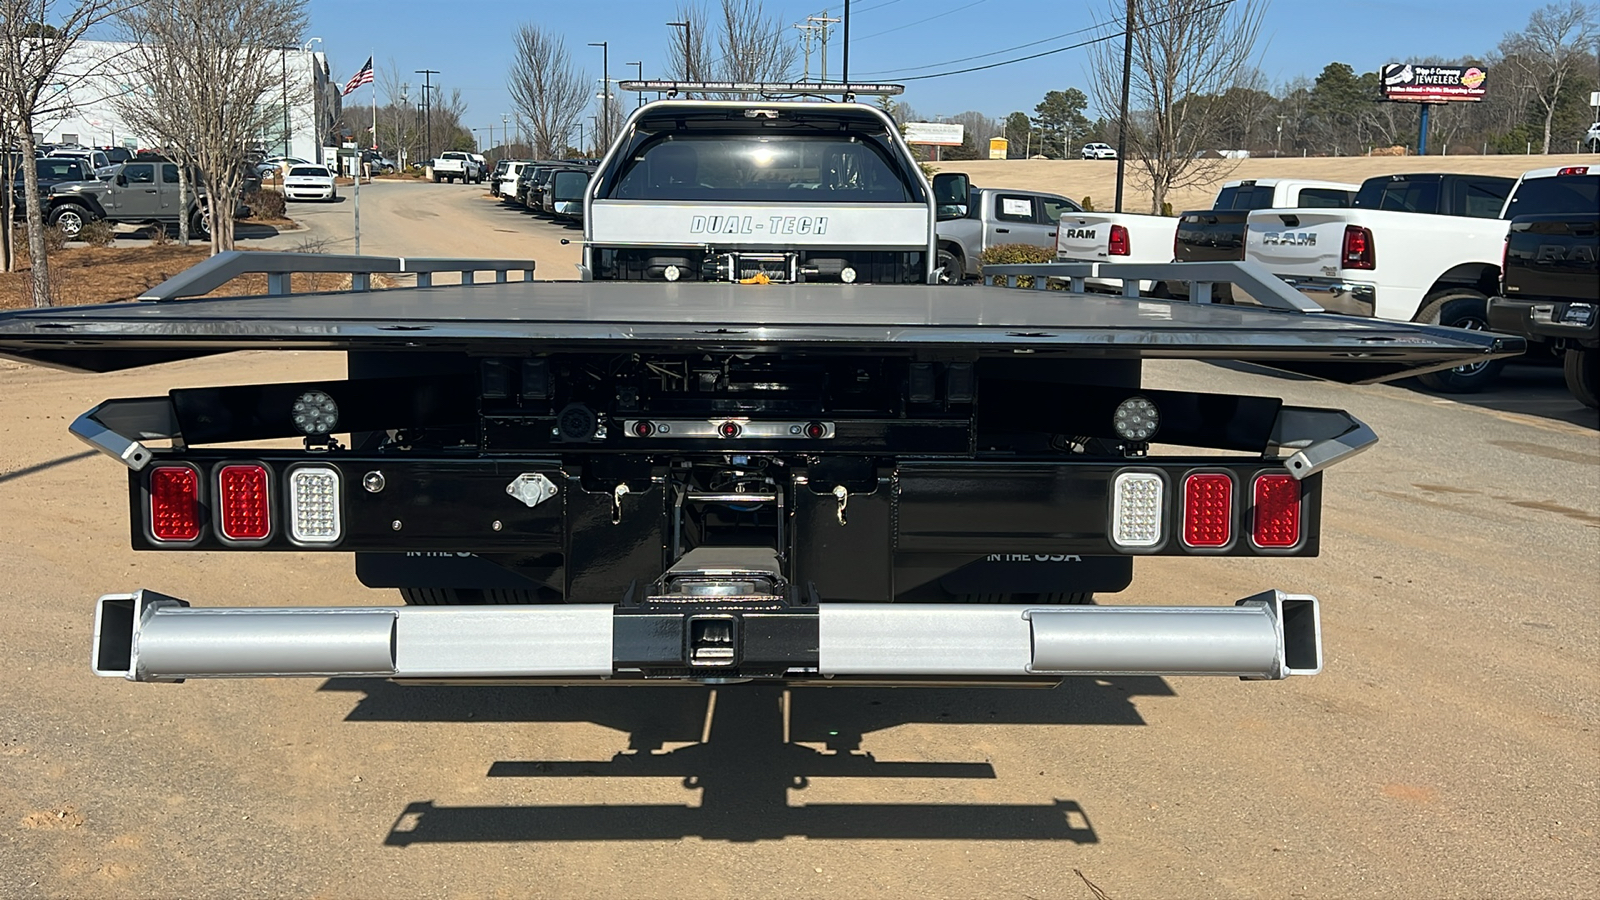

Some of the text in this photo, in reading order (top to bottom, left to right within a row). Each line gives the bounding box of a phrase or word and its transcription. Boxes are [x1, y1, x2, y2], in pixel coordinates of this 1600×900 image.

[1415, 74, 1459, 86] JEWELERS
[1066, 229, 1096, 240] RAM
[1263, 232, 1318, 247] RAM
[1535, 244, 1600, 264] RA
